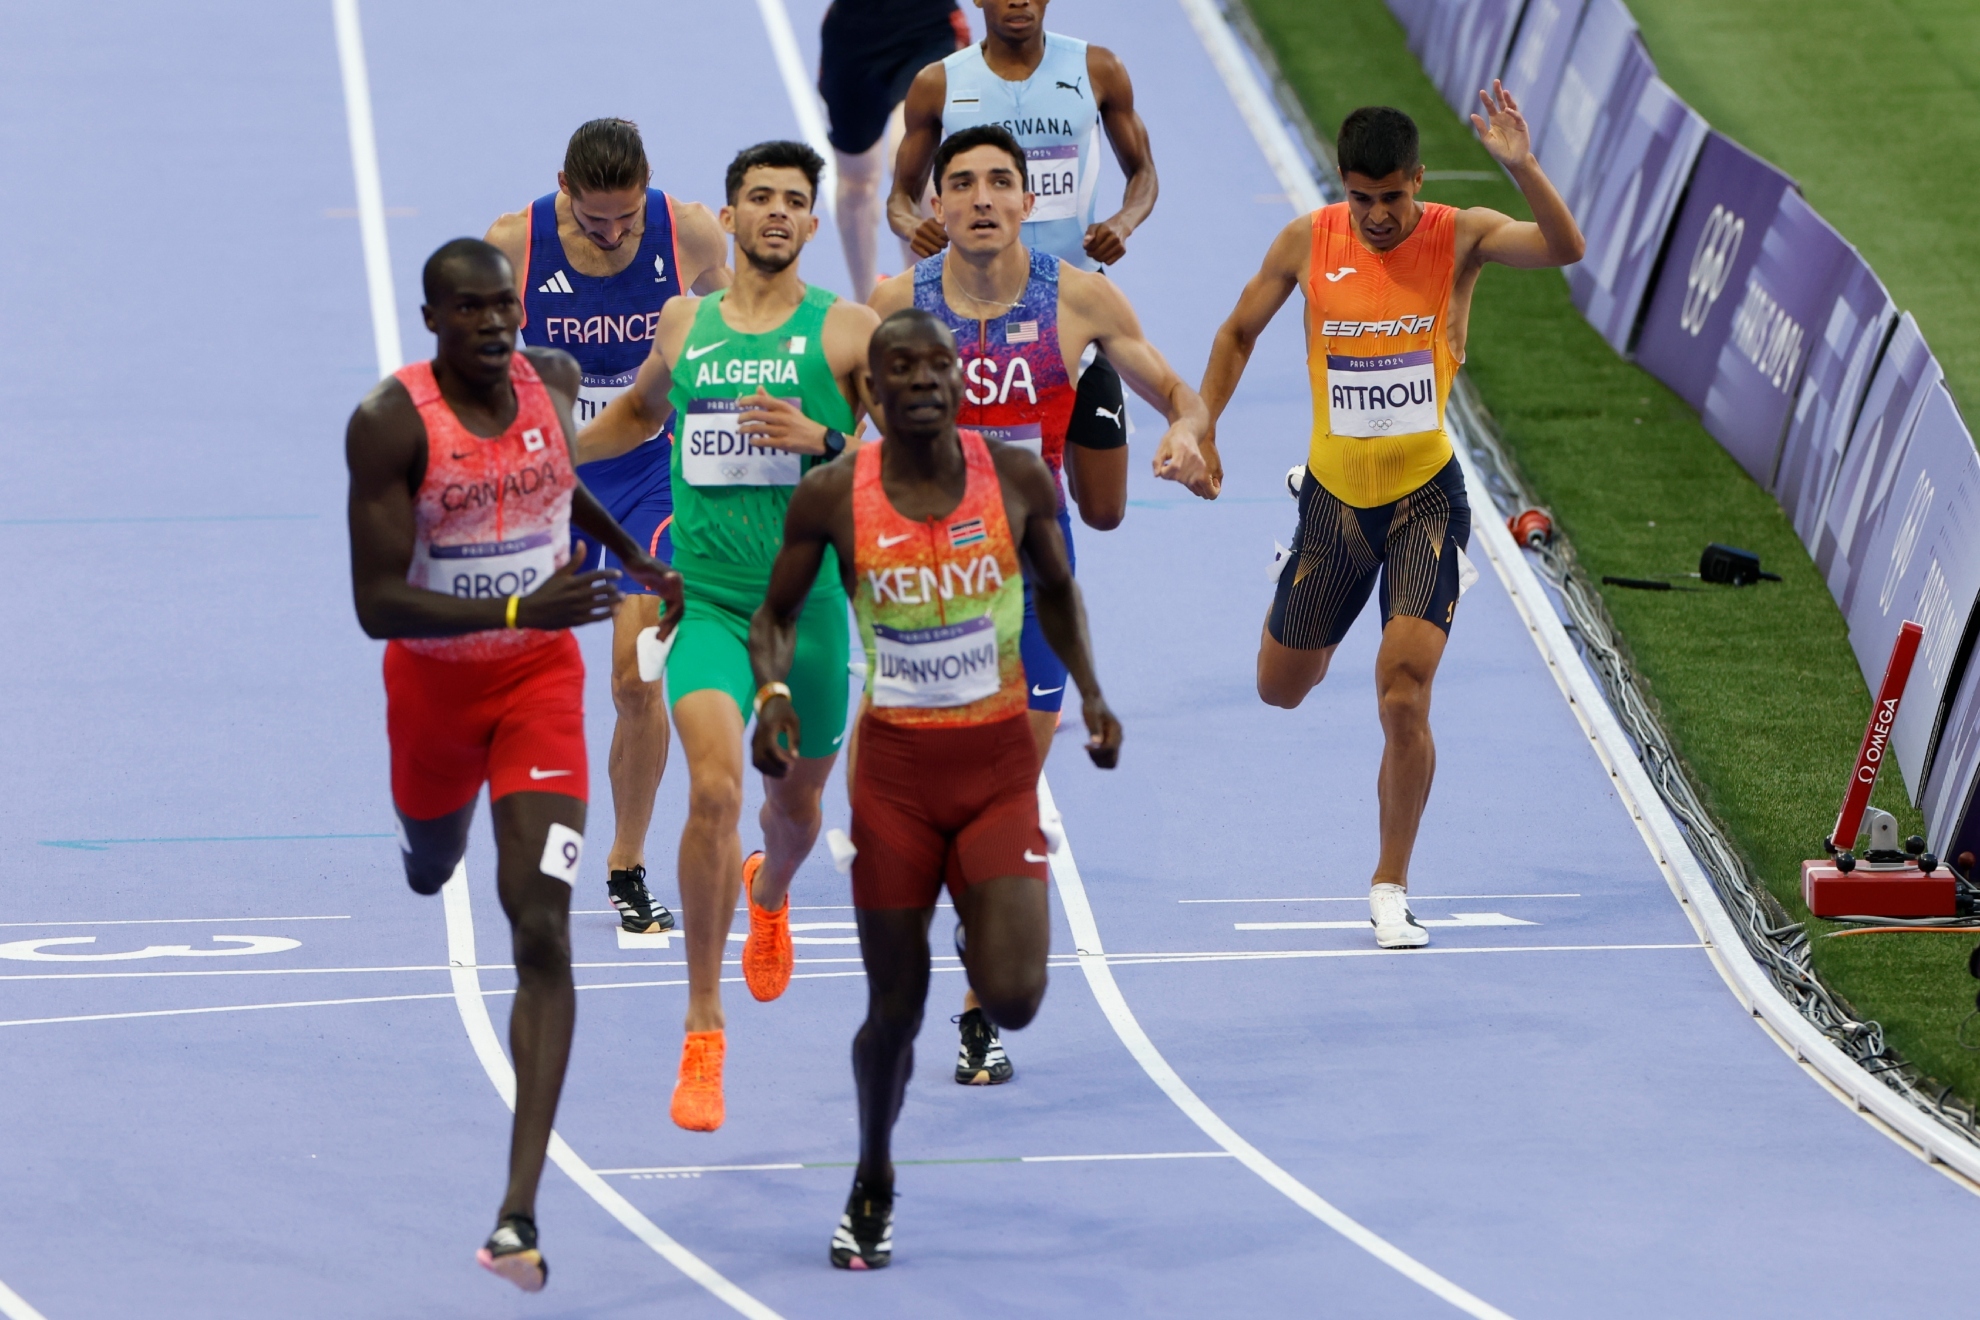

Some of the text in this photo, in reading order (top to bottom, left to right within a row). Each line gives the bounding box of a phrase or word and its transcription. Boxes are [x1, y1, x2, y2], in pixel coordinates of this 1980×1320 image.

[991, 118, 1072, 136] SWANA
[1027, 149, 1051, 158] 2024
[1026, 172, 1073, 196] LELA
[546, 312, 660, 344] FRANCE
[1322, 315, 1436, 338] ESPAÑA
[695, 359, 799, 387] ALGERIA
[1350, 358, 1404, 368] PARIS 2024
[609, 374, 633, 385] 2024
[957, 357, 1037, 405] SA
[707, 401, 736, 411] PARIS
[1332, 379, 1433, 410] ATTAOUI
[442, 462, 557, 513] CANADA
[453, 567, 537, 599] AROP
[868, 555, 1003, 604] KENYA
[880, 644, 995, 684] WANYONYI
[1866, 698, 1899, 762] OMEGA
[563, 841, 578, 869] 9
